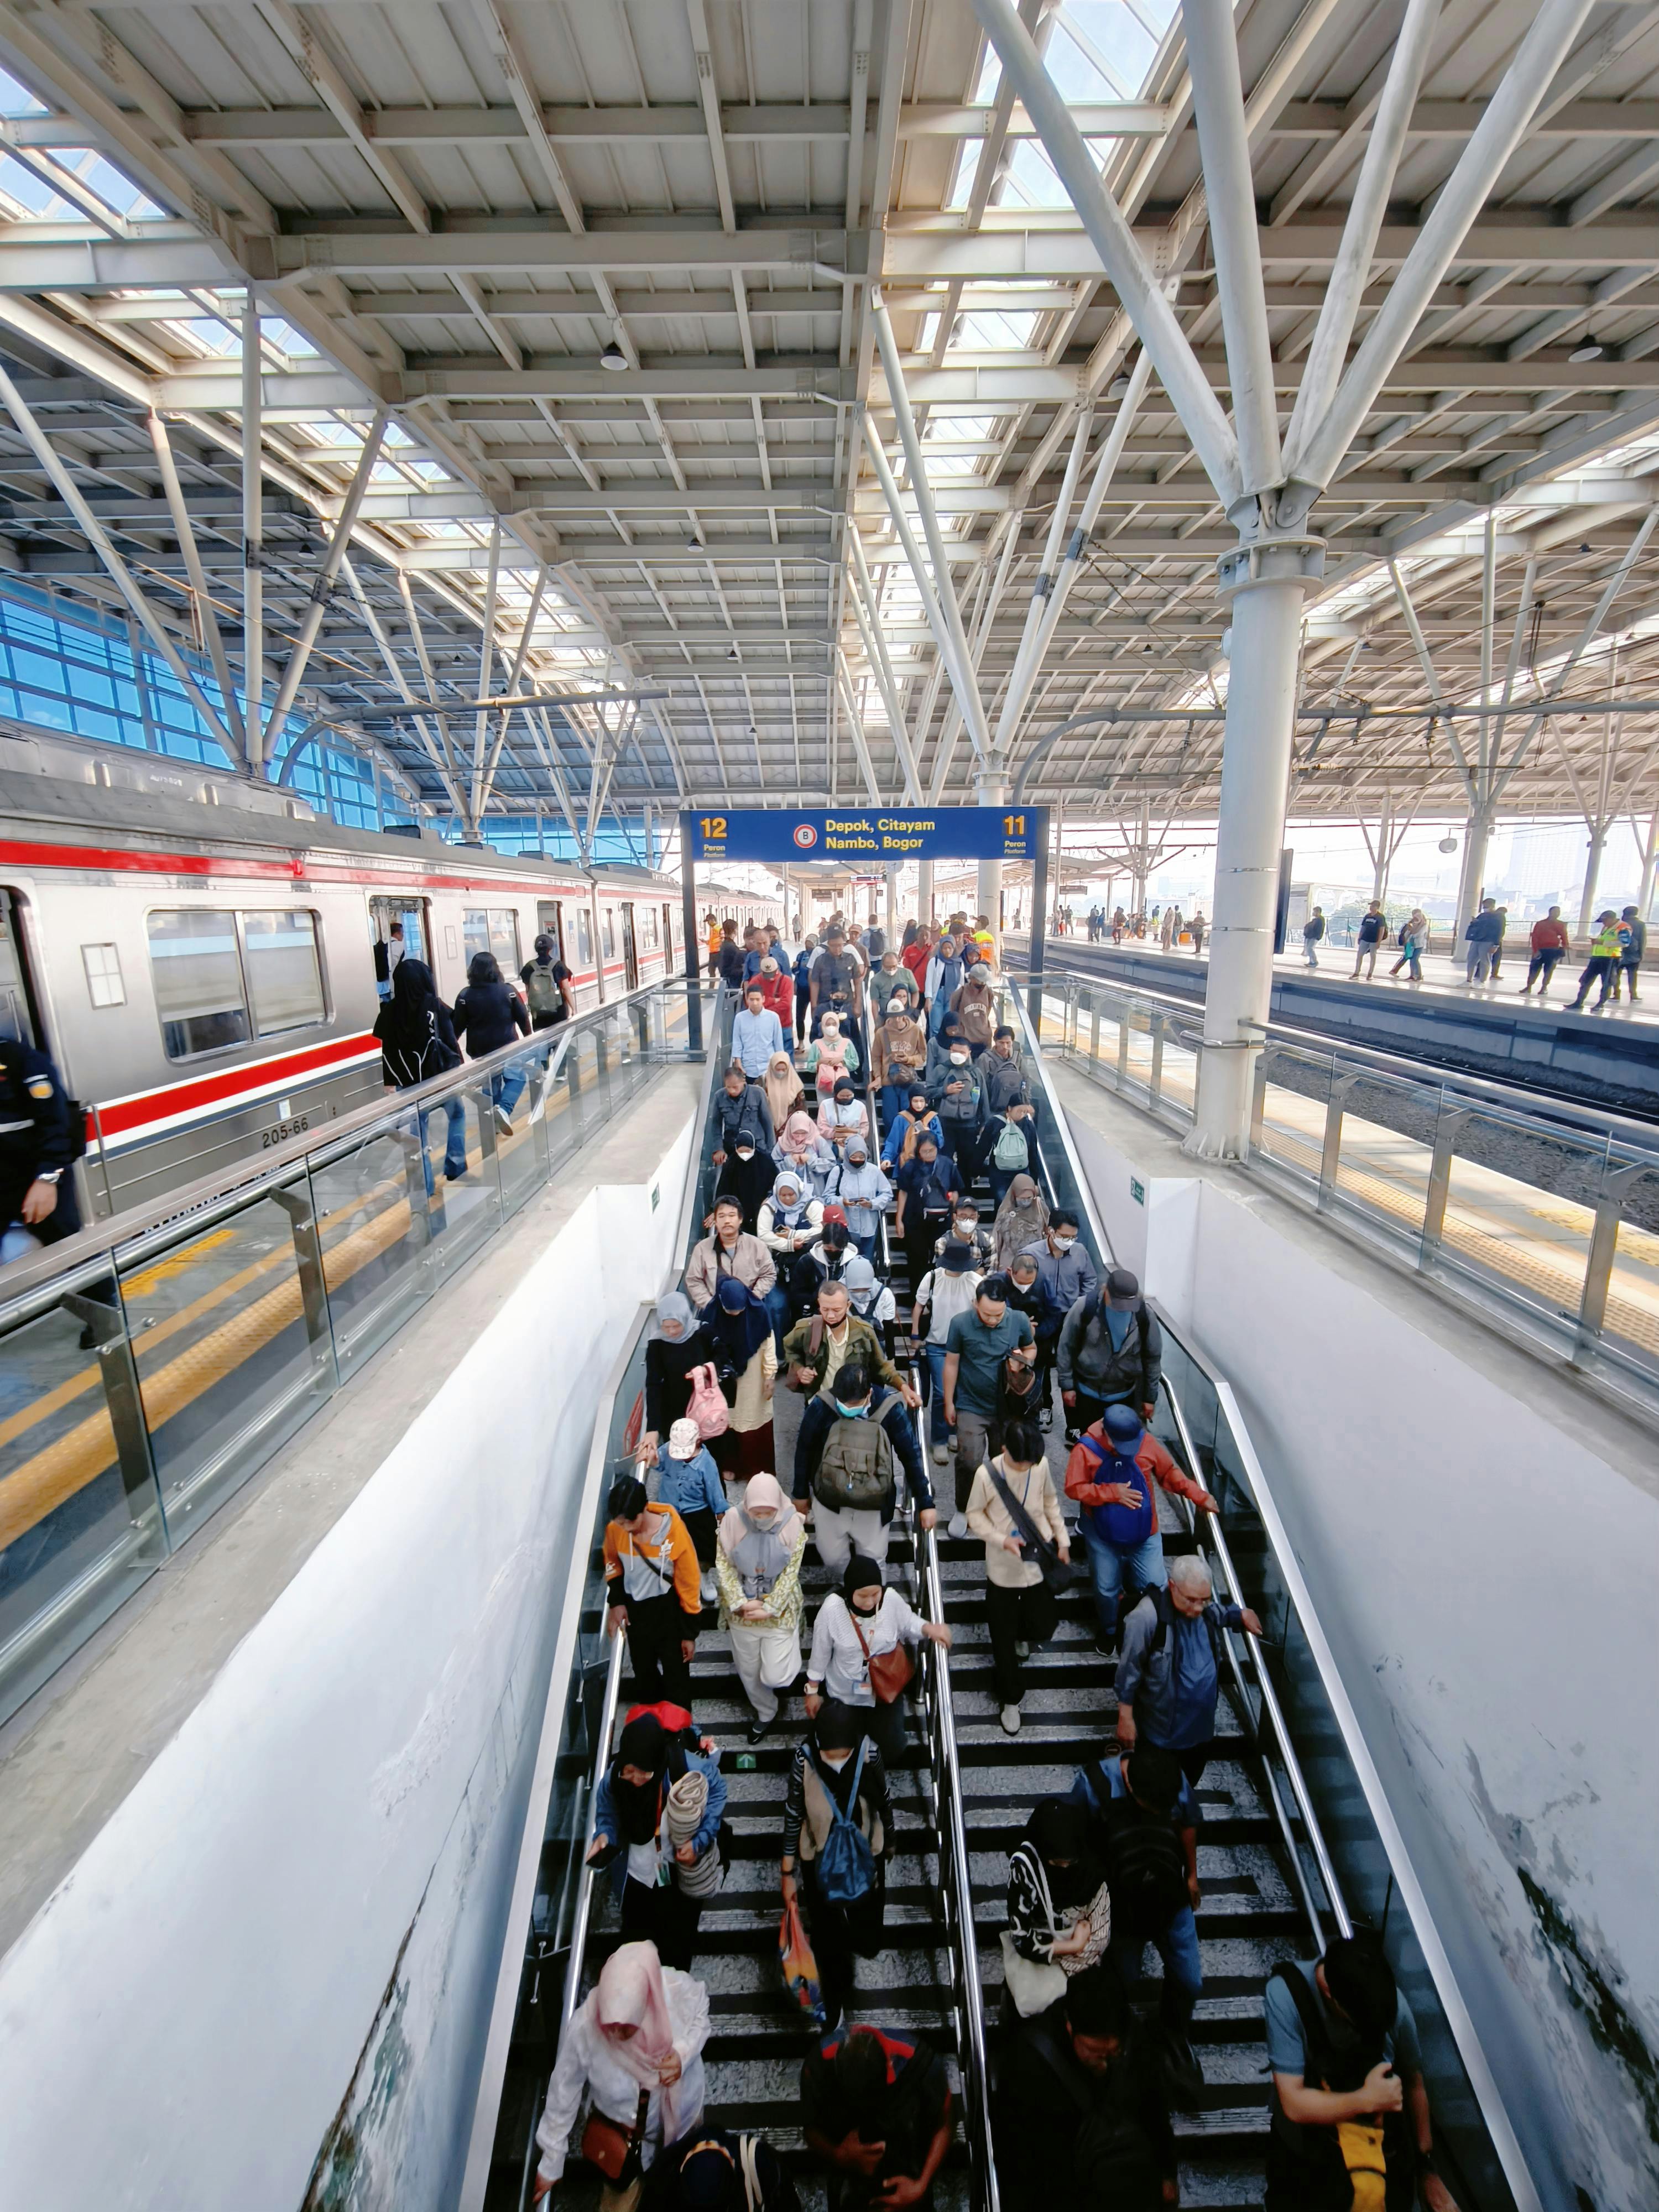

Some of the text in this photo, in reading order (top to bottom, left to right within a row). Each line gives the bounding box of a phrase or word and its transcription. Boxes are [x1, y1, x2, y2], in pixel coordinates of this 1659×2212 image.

[700, 817, 727, 838] 12
[826, 818, 935, 834] Depok, Citayam
[1004, 815, 1025, 835] 11
[802, 831, 808, 839] B
[826, 836, 924, 851] Nambo, Bogor
[262, 1117, 309, 1149] 205-66
